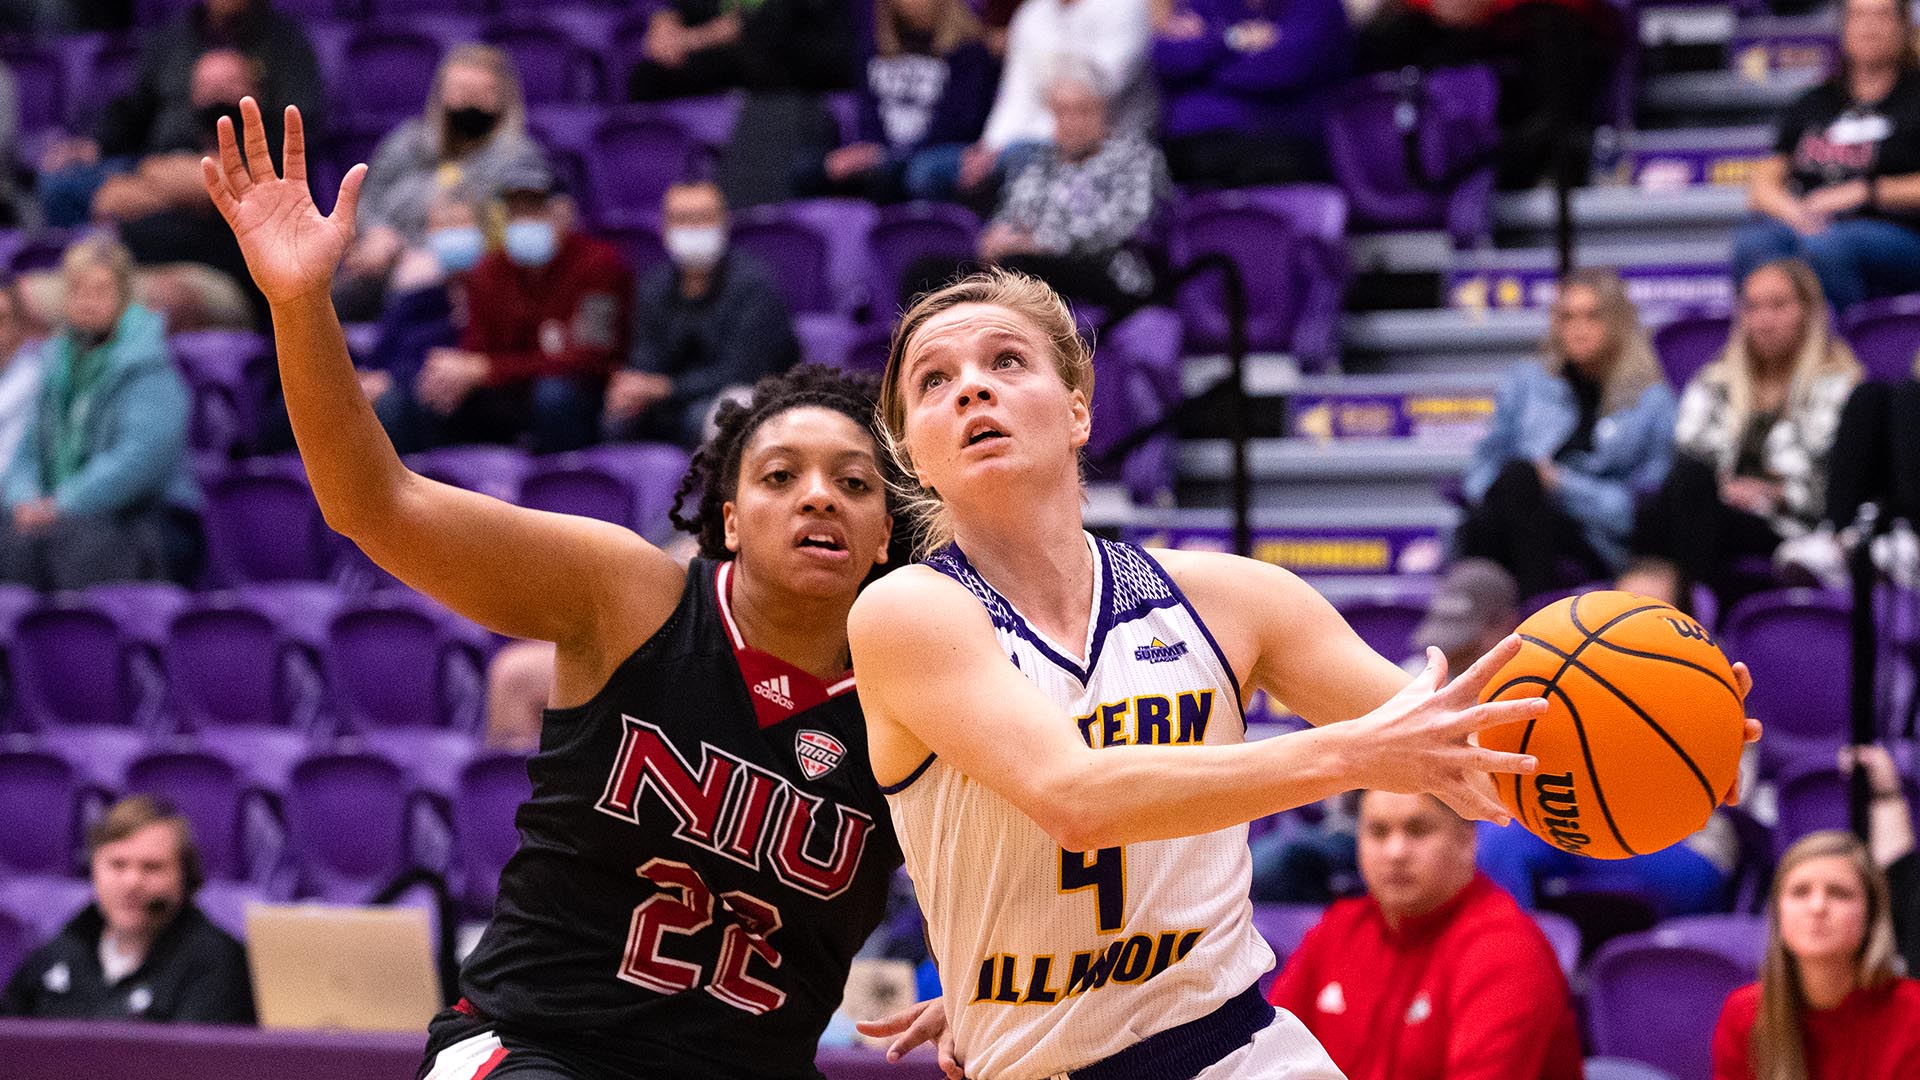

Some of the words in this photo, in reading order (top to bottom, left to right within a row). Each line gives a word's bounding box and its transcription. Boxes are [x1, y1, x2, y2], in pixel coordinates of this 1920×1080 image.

[1134, 641, 1189, 661] SUMMIT
[753, 684, 795, 710] adidas
[798, 742, 839, 768] MAC
[594, 713, 875, 900] NIU
[1057, 845, 1126, 935] 4
[616, 857, 787, 1015] 22
